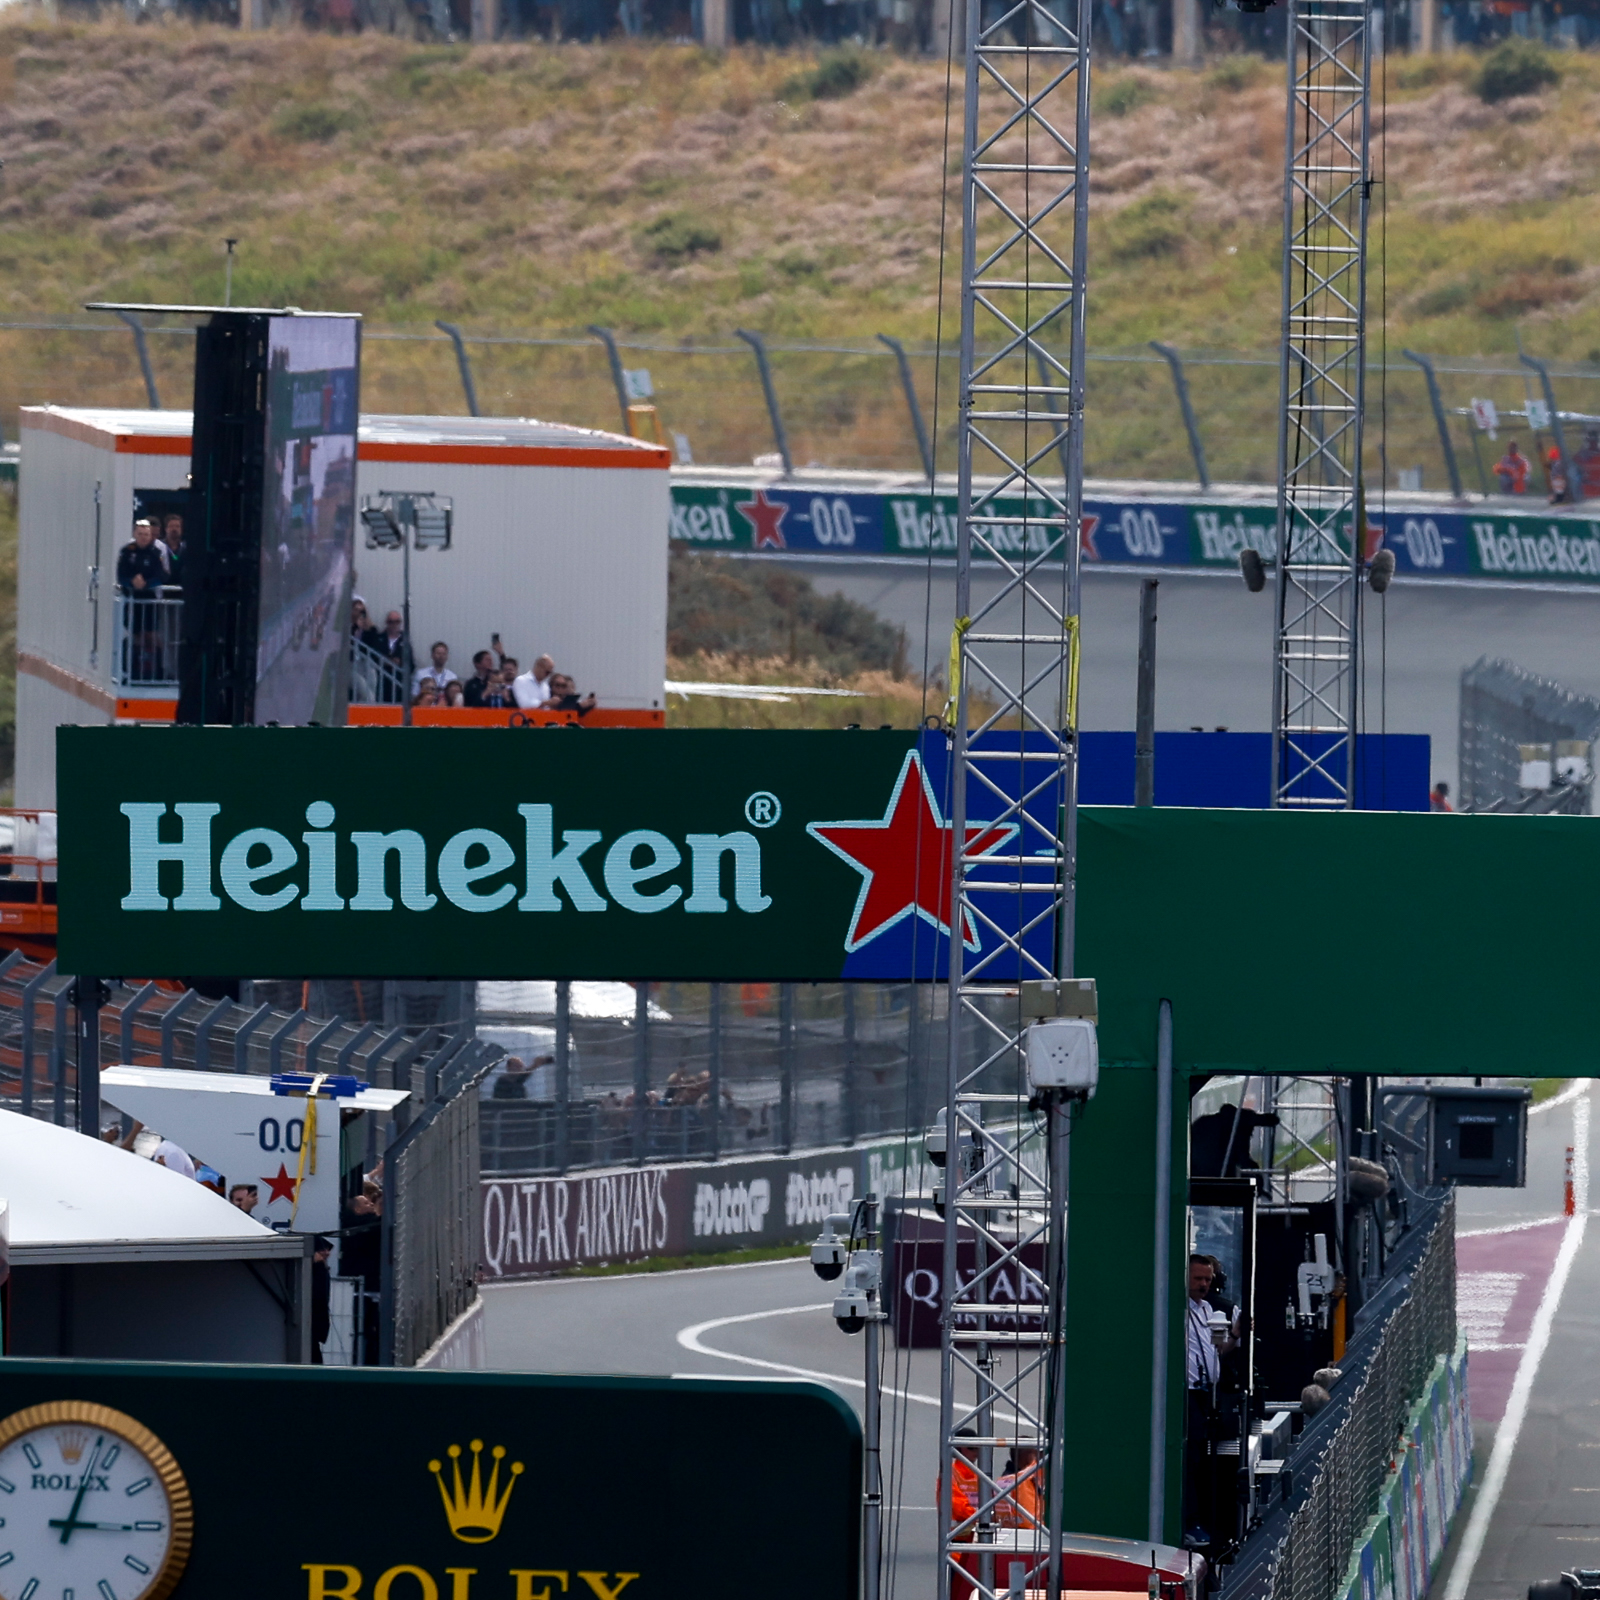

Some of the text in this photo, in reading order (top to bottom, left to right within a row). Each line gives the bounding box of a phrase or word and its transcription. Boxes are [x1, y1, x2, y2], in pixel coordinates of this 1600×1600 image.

[120, 800, 773, 914] Heineken
[484, 1169, 669, 1275] QATAR AIRWAYS
[31, 1473, 110, 1493] ROLEX
